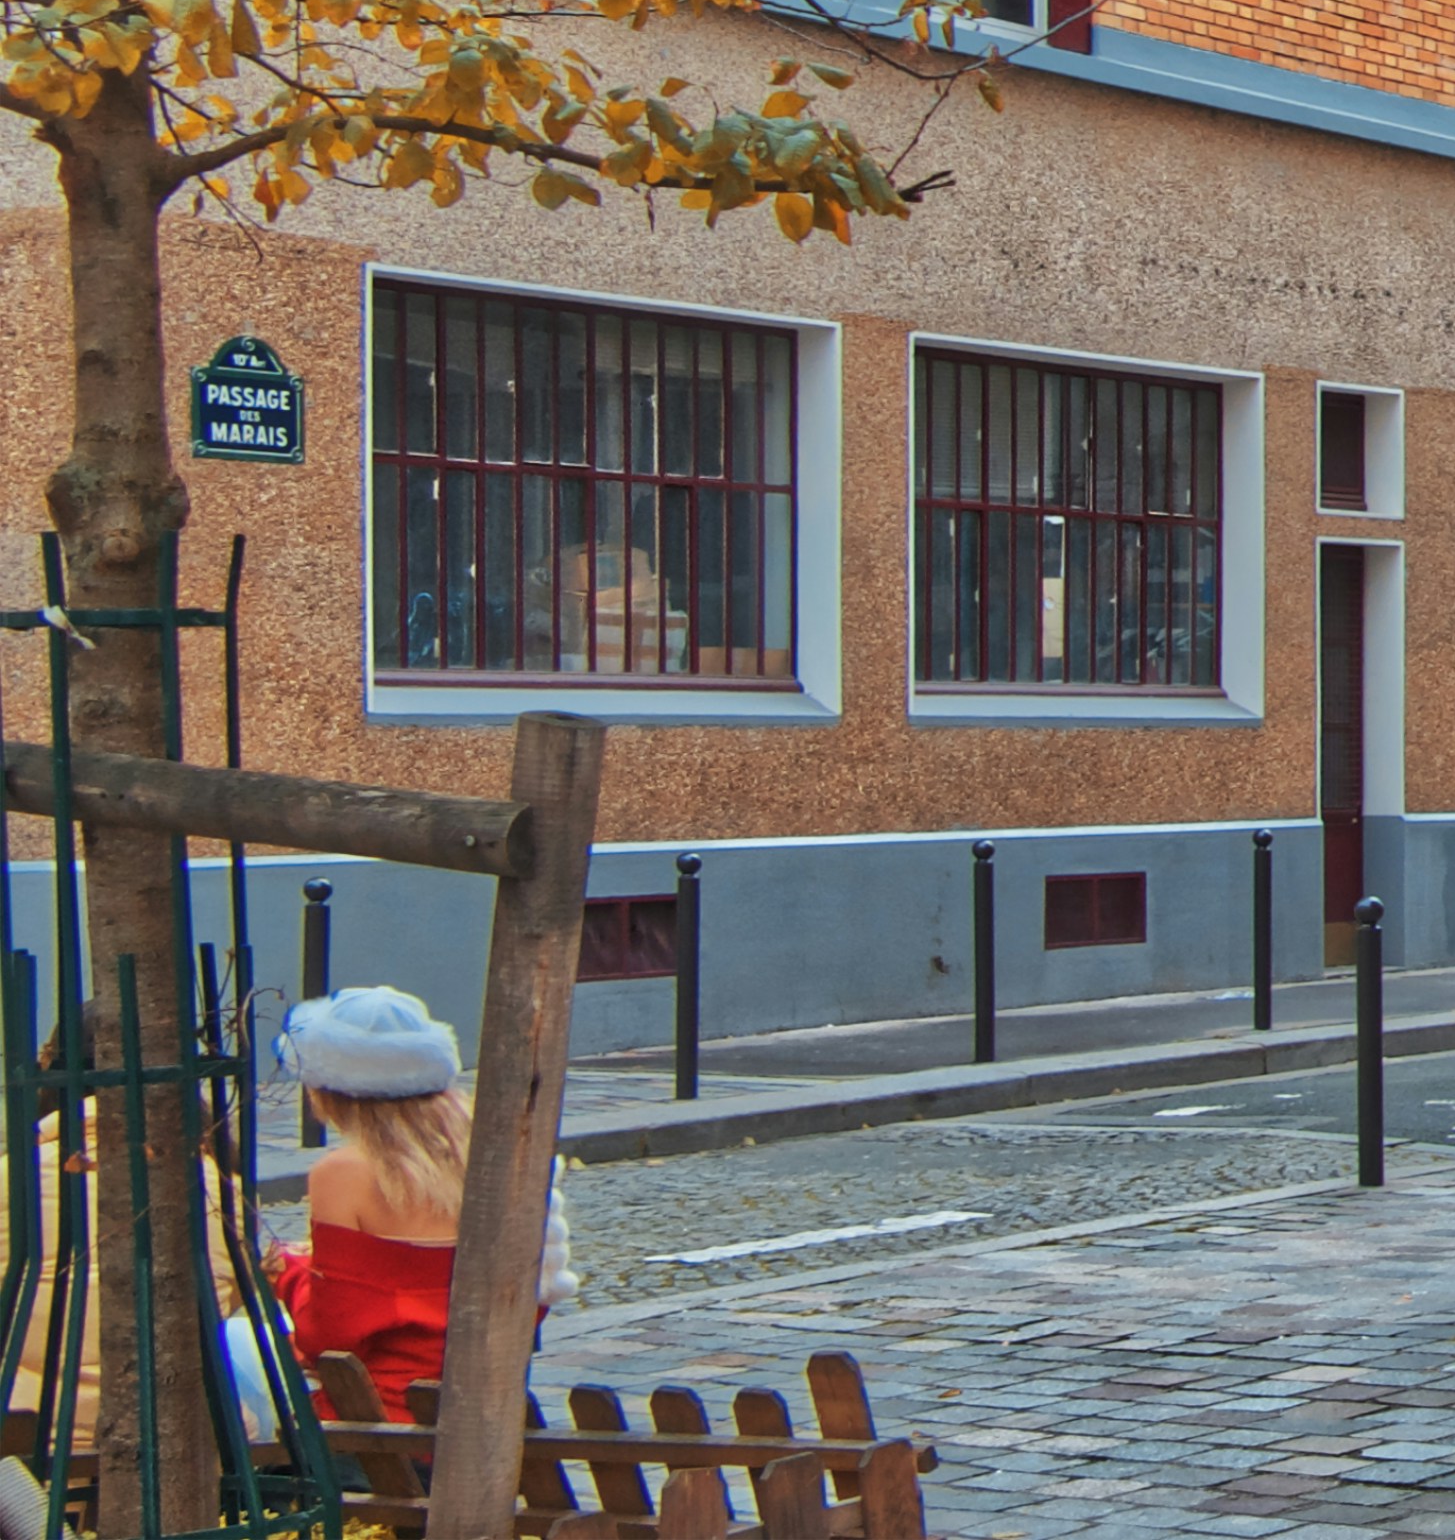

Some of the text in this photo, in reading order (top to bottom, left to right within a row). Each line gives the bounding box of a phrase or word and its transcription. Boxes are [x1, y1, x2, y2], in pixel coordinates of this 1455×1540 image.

[206, 384, 291, 411] PASSAGE
[239, 410, 261, 423] DES
[211, 422, 288, 447] MARAIS
